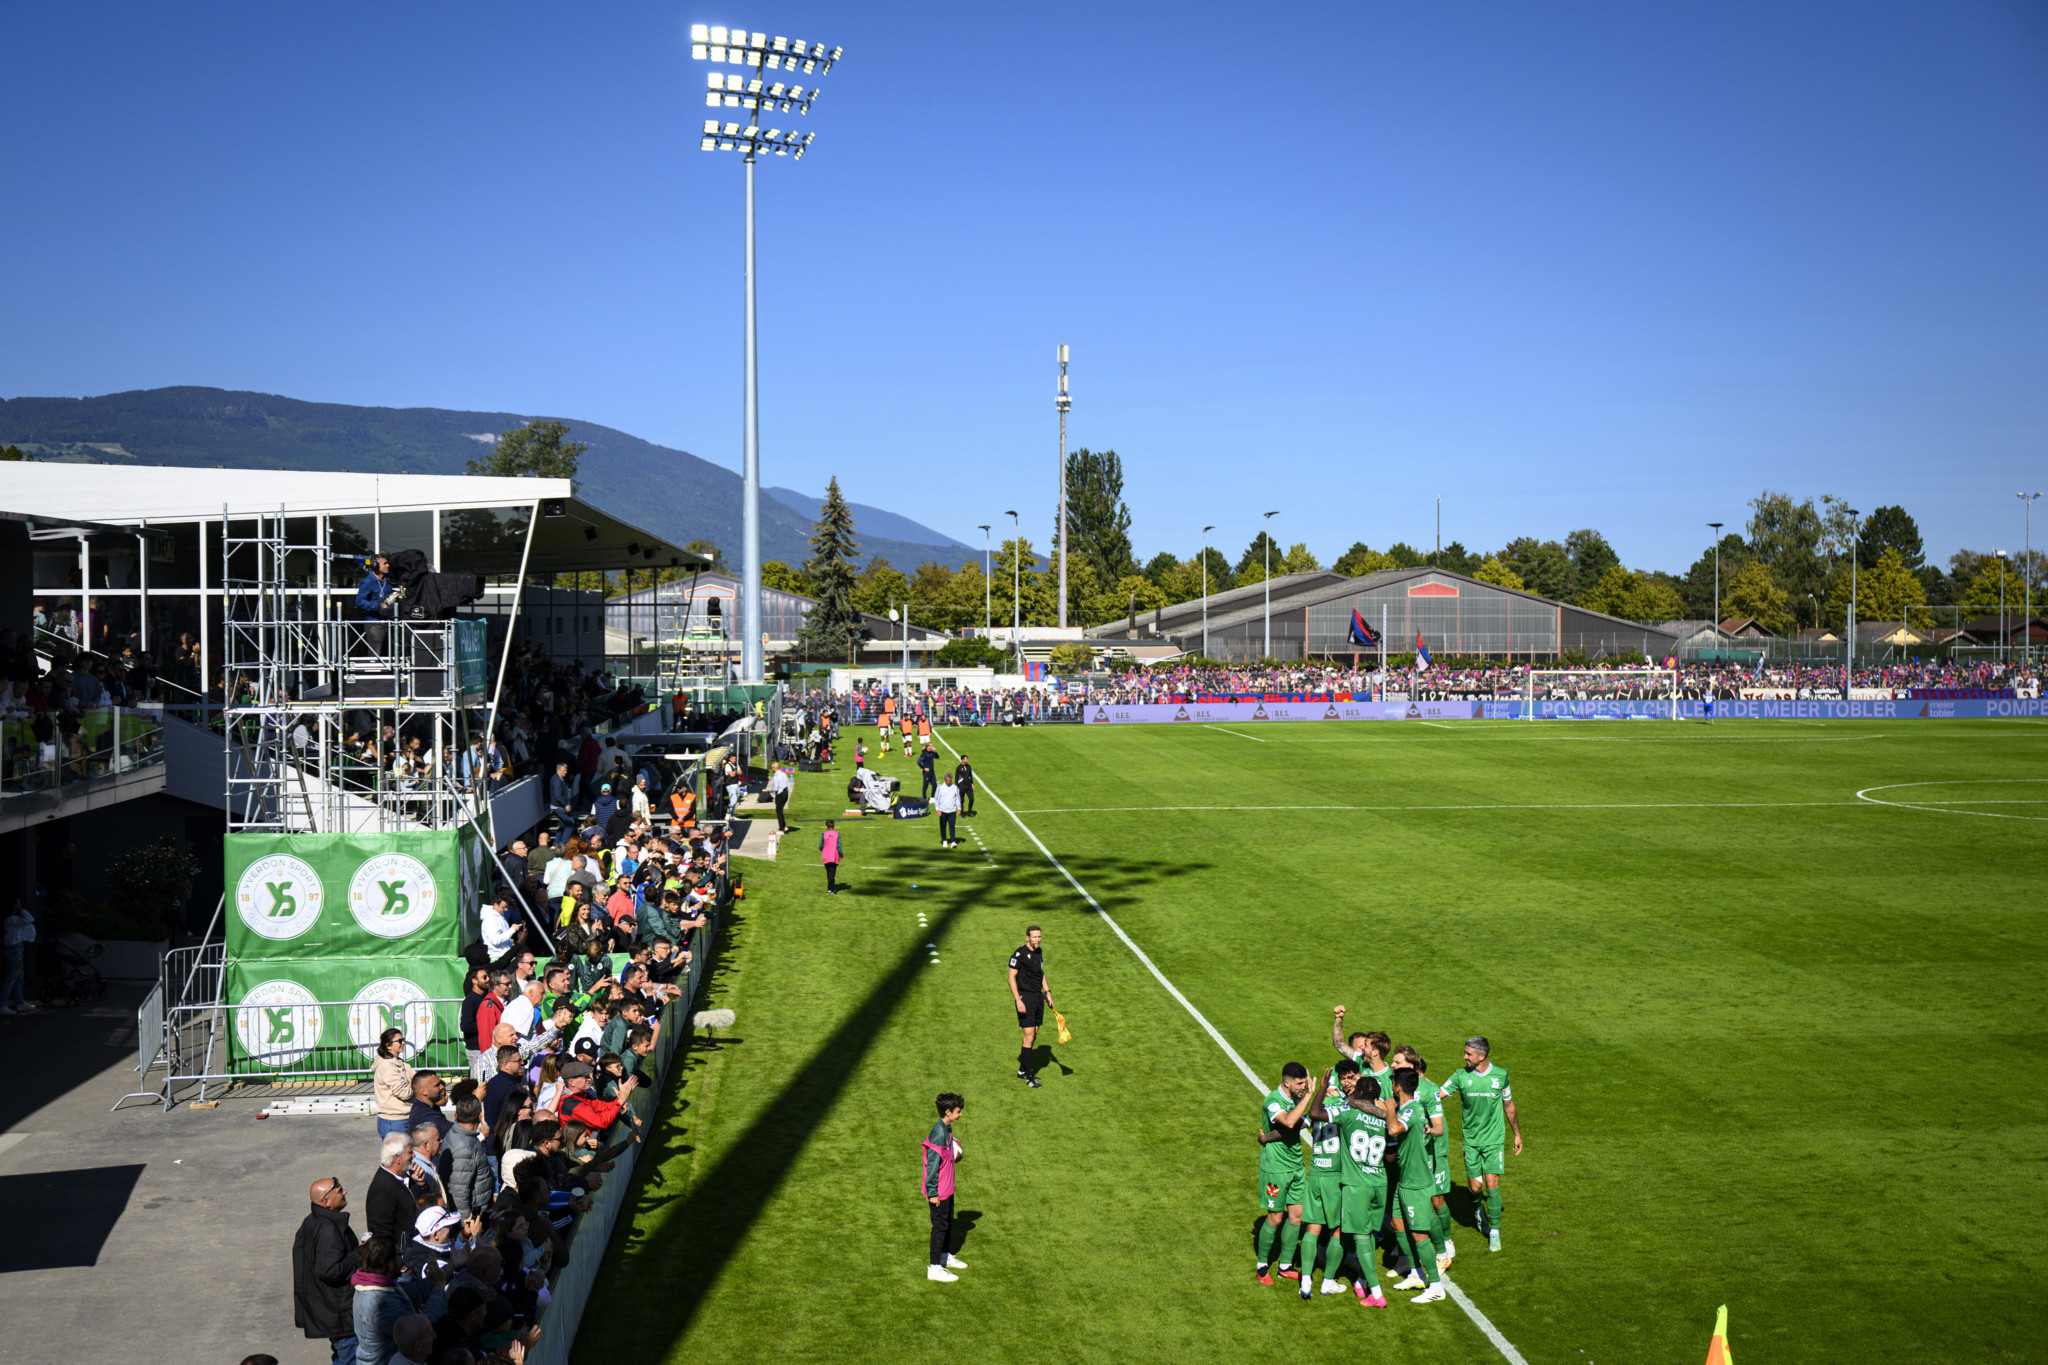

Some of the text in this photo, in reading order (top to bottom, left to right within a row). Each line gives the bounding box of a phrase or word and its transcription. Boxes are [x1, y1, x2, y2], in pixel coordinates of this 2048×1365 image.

[1484, 702, 1509, 710] meier
[1543, 702, 1620, 715] POMPES
[1735, 702, 1759, 717] DE
[1764, 702, 1820, 717] MEIER
[1824, 702, 1897, 717] TOBLER
[1930, 701, 1955, 709] meier
[1930, 709, 1955, 717] tobler
[243, 859, 316, 889] YVERDON SPORT
[355, 858, 429, 887] YVERDON SPORT
[240, 892, 320, 902] 18 97
[353, 890, 433, 901] 18 97
[307, 1018, 319, 1027] 97
[419, 1016, 430, 1024] 97
[1349, 1129, 1386, 1167] 88
[1435, 1170, 1446, 1184] 27
[1407, 1206, 1415, 1218] 5
